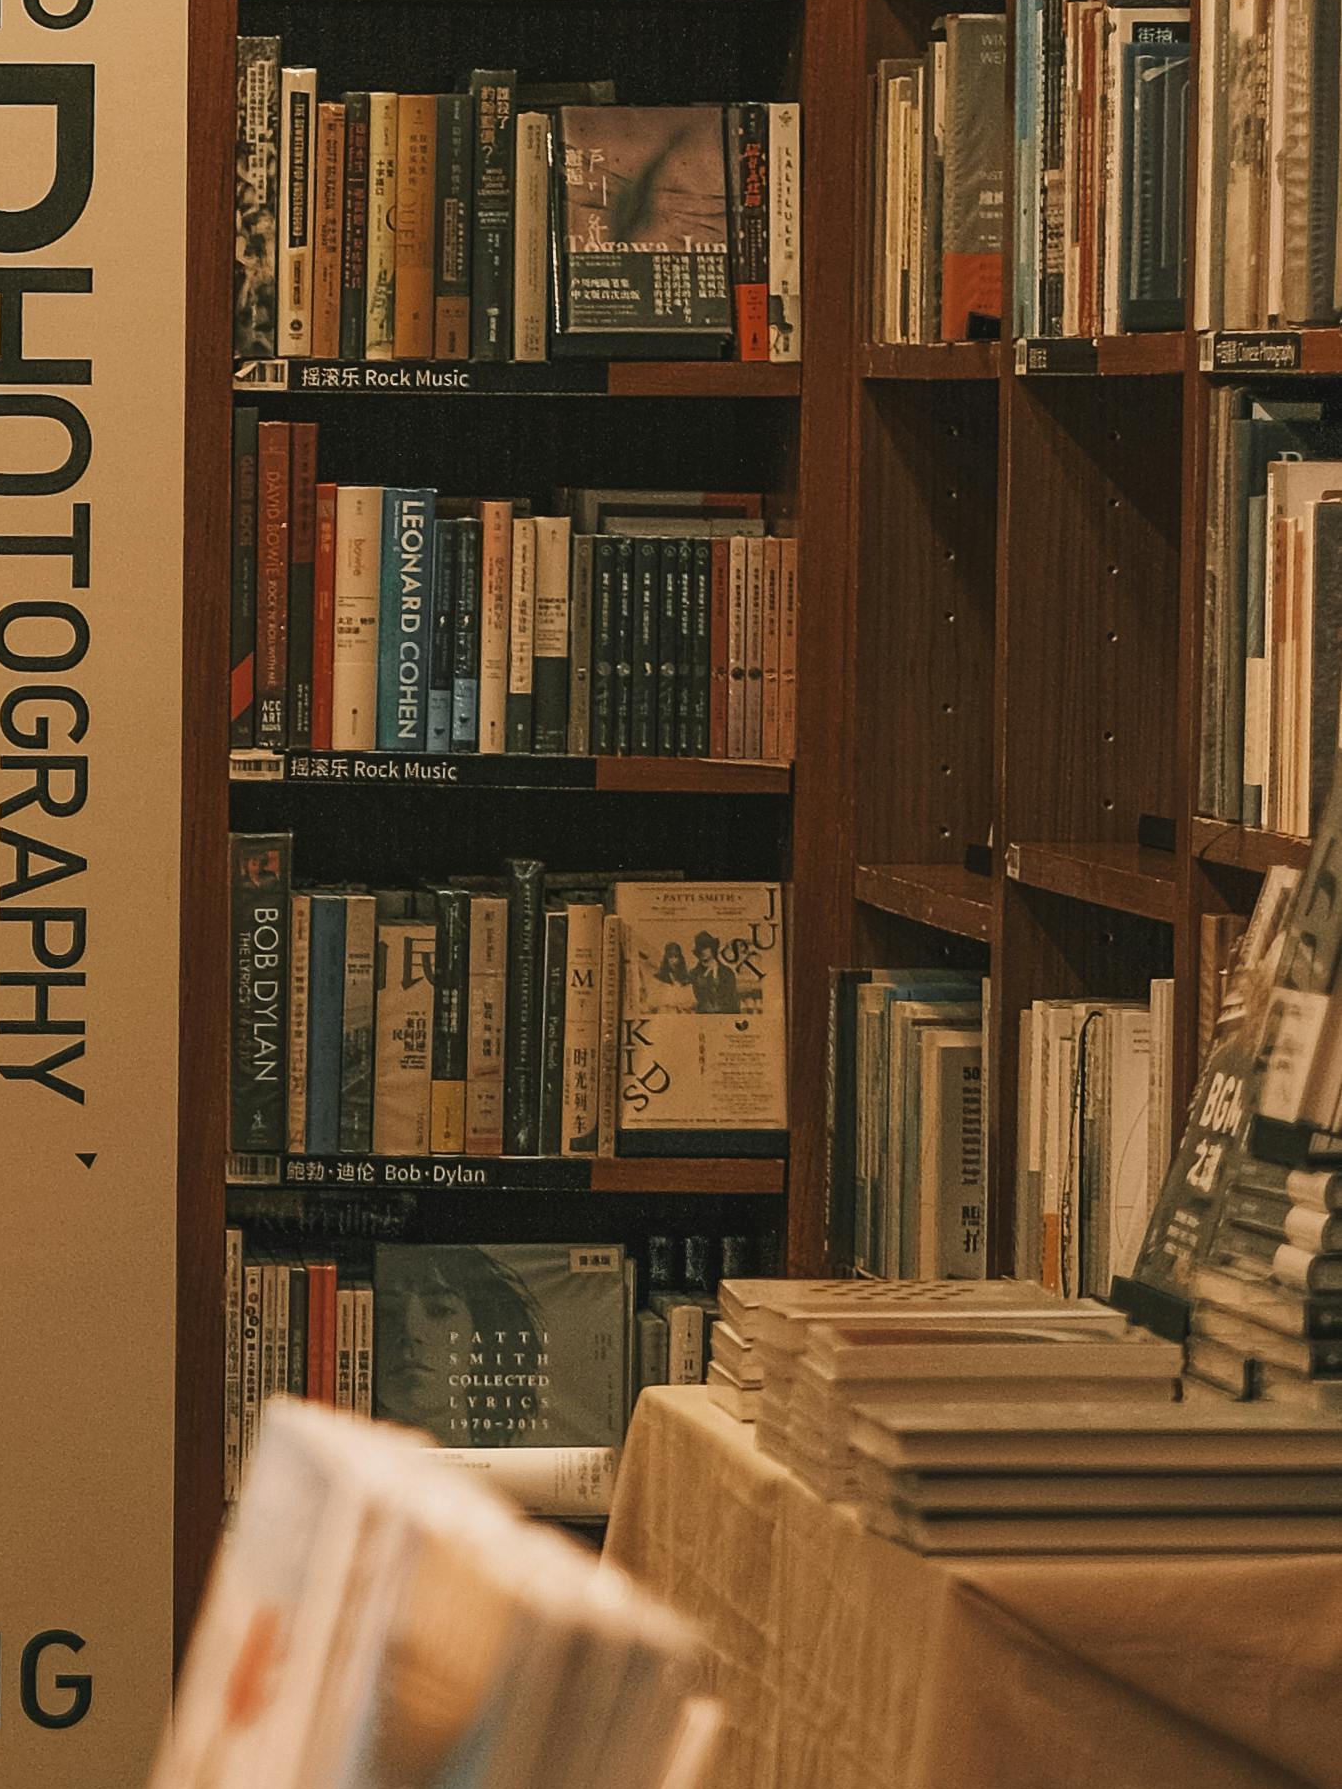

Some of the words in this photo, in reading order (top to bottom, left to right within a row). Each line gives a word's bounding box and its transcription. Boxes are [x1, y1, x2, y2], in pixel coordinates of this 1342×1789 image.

[567, 235, 668, 253] Togawa
[682, 235, 728, 253] Jun
[301, 367, 360, 389] 摇滚乐
[366, 368, 411, 389] Rock
[416, 368, 470, 389] Music
[266, 472, 281, 521] DAVID
[266, 525, 281, 576] BOWIE
[400, 500, 425, 634] LEONARD
[397, 641, 421, 739] COHEN
[261, 700, 282, 712] ACC
[261, 712, 282, 723] ART
[291, 758, 349, 778] 摇滚乐
[354, 759, 399, 780] Rock
[406, 760, 458, 781] Music
[664, 893, 696, 903] PATTI
[697, 893, 734, 903] SMITH
[238, 931, 252, 955] THE
[254, 907, 280, 969] BOB
[570, 969, 594, 988] M
[253, 981, 279, 1082] DYLAN
[448, 1330, 550, 1344] PATTI
[448, 1353, 550, 1366] SMITH
[448, 1374, 551, 1387] COLLECTED
[448, 1396, 549, 1409] LYRICS
